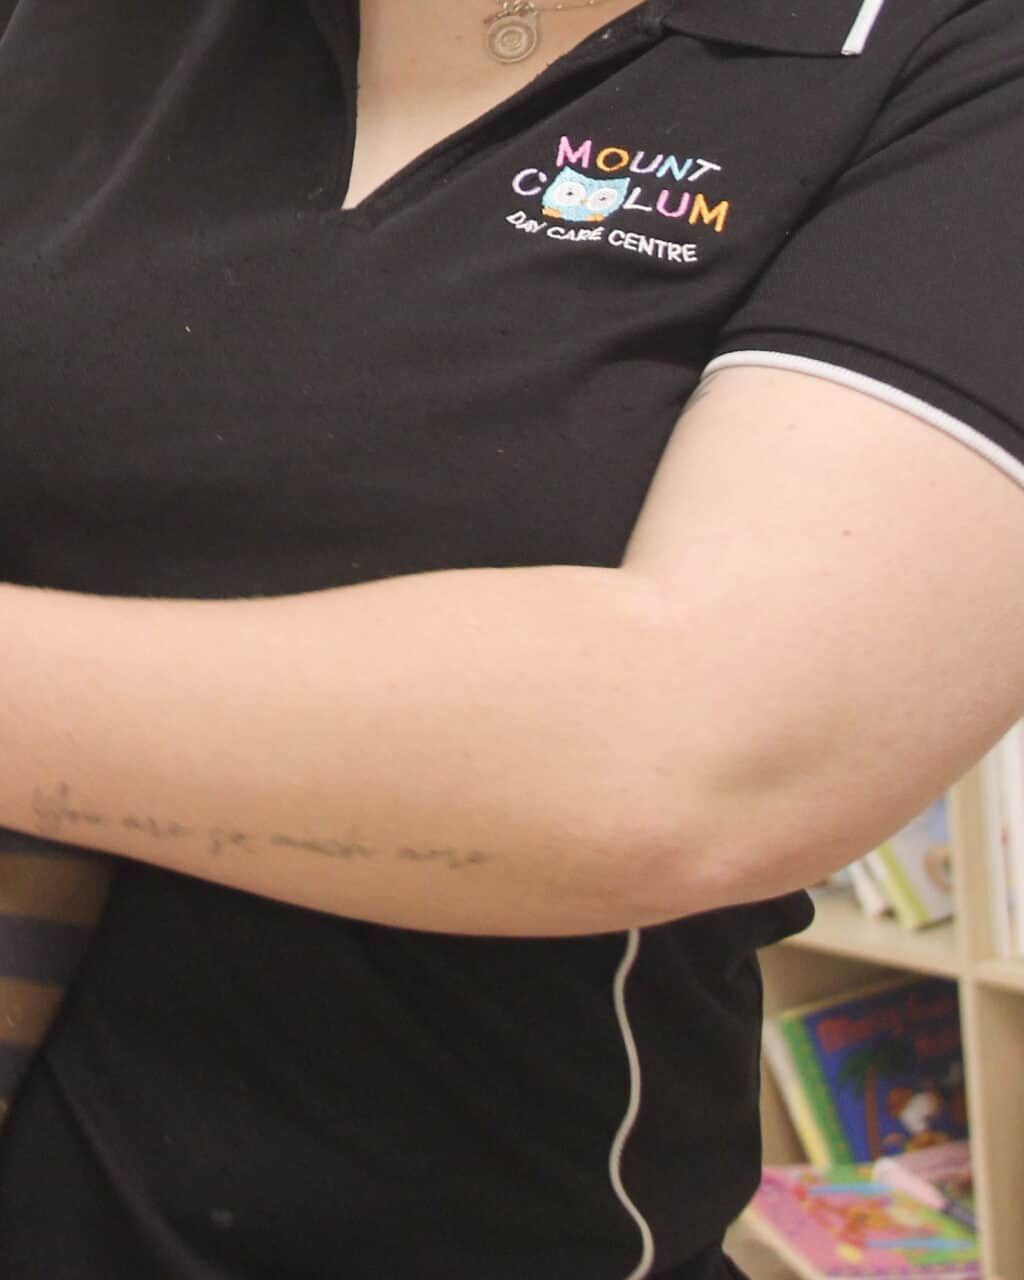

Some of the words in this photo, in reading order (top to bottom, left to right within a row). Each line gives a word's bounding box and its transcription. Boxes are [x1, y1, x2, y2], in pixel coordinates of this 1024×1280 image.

[555, 135, 722, 182] MOUNT
[505, 210, 547, 233] DAY
[546, 225, 604, 242] CARE
[607, 228, 698, 263] CENTRE
